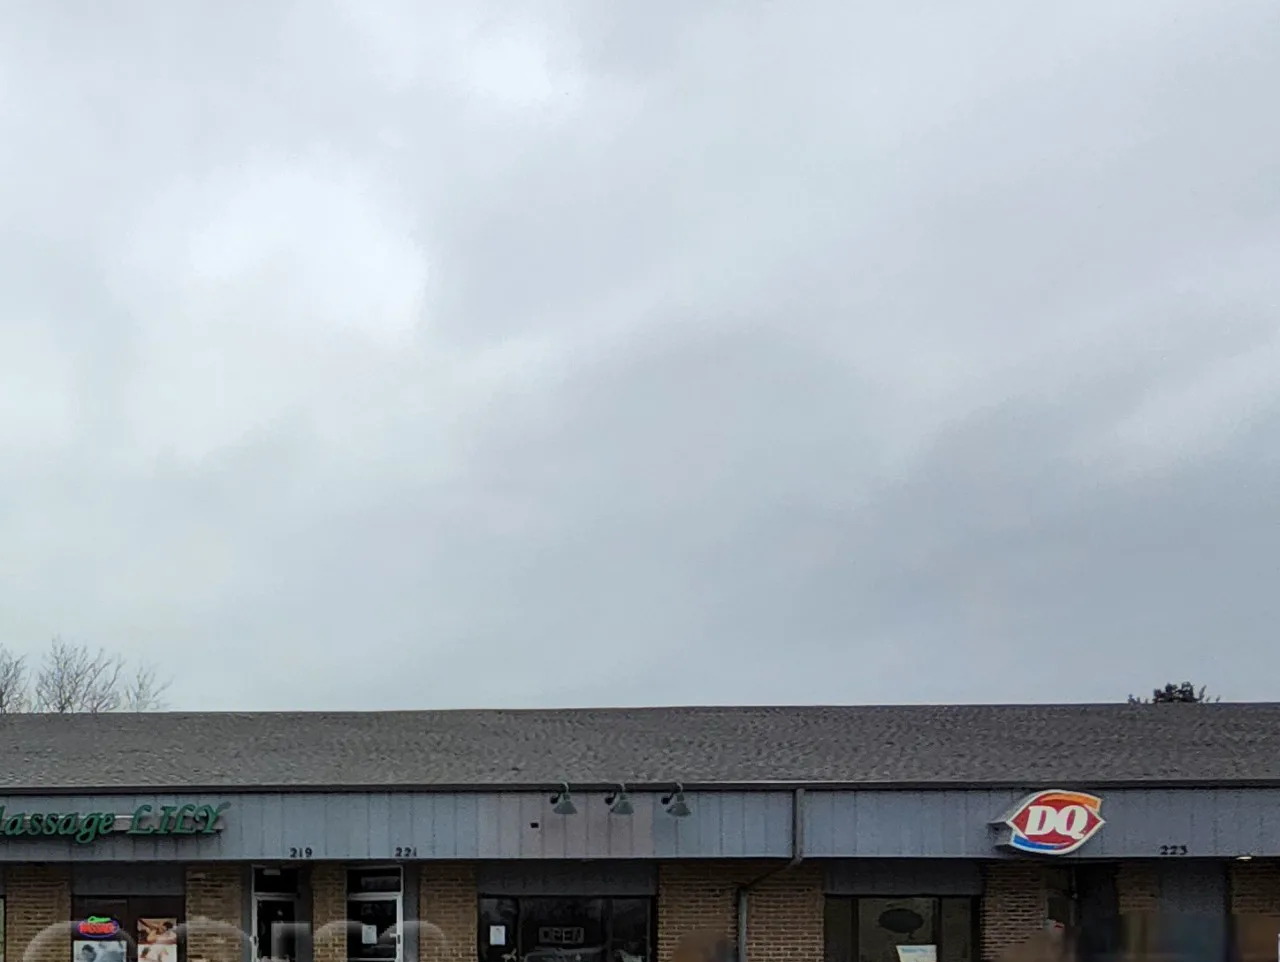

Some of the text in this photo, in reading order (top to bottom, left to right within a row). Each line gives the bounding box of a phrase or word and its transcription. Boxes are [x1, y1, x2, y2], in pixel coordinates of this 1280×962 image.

[1025, 805, 1089, 840] DQ
[289, 847, 313, 858] 219
[395, 846, 418, 857] 221
[1160, 844, 1189, 856] 223
